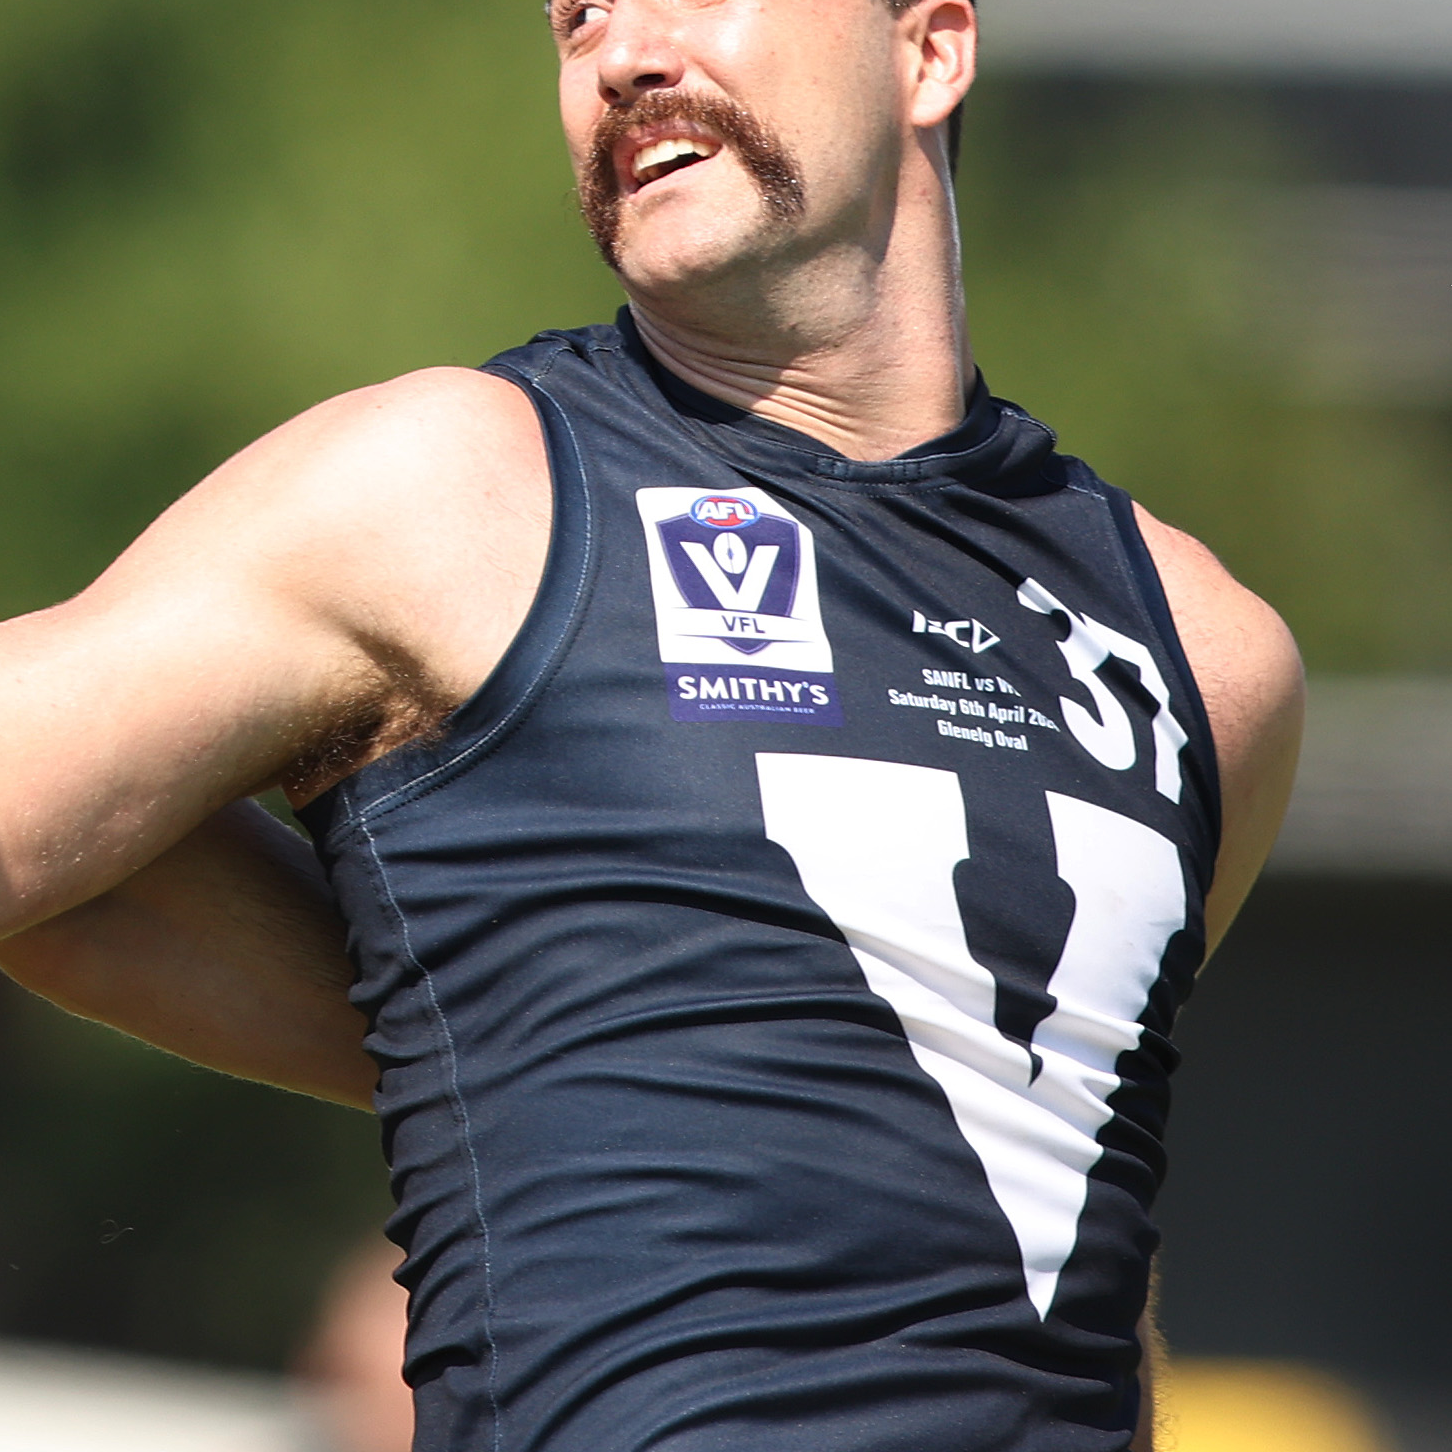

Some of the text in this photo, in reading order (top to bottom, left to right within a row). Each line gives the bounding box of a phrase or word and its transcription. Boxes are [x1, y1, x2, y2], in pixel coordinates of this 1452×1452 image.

[697, 501, 755, 520] AFL
[722, 615, 765, 634] VFL
[678, 676, 829, 705] SMITHY'S
[922, 668, 971, 690] SANFL
[975, 677, 994, 692] vs
[738, 704, 792, 712] AUSTRALIAN
[888, 689, 957, 715] Saturday
[959, 699, 985, 717] 6th
[988, 702, 1025, 724] April
[937, 719, 1028, 751] Glenelg Oval
